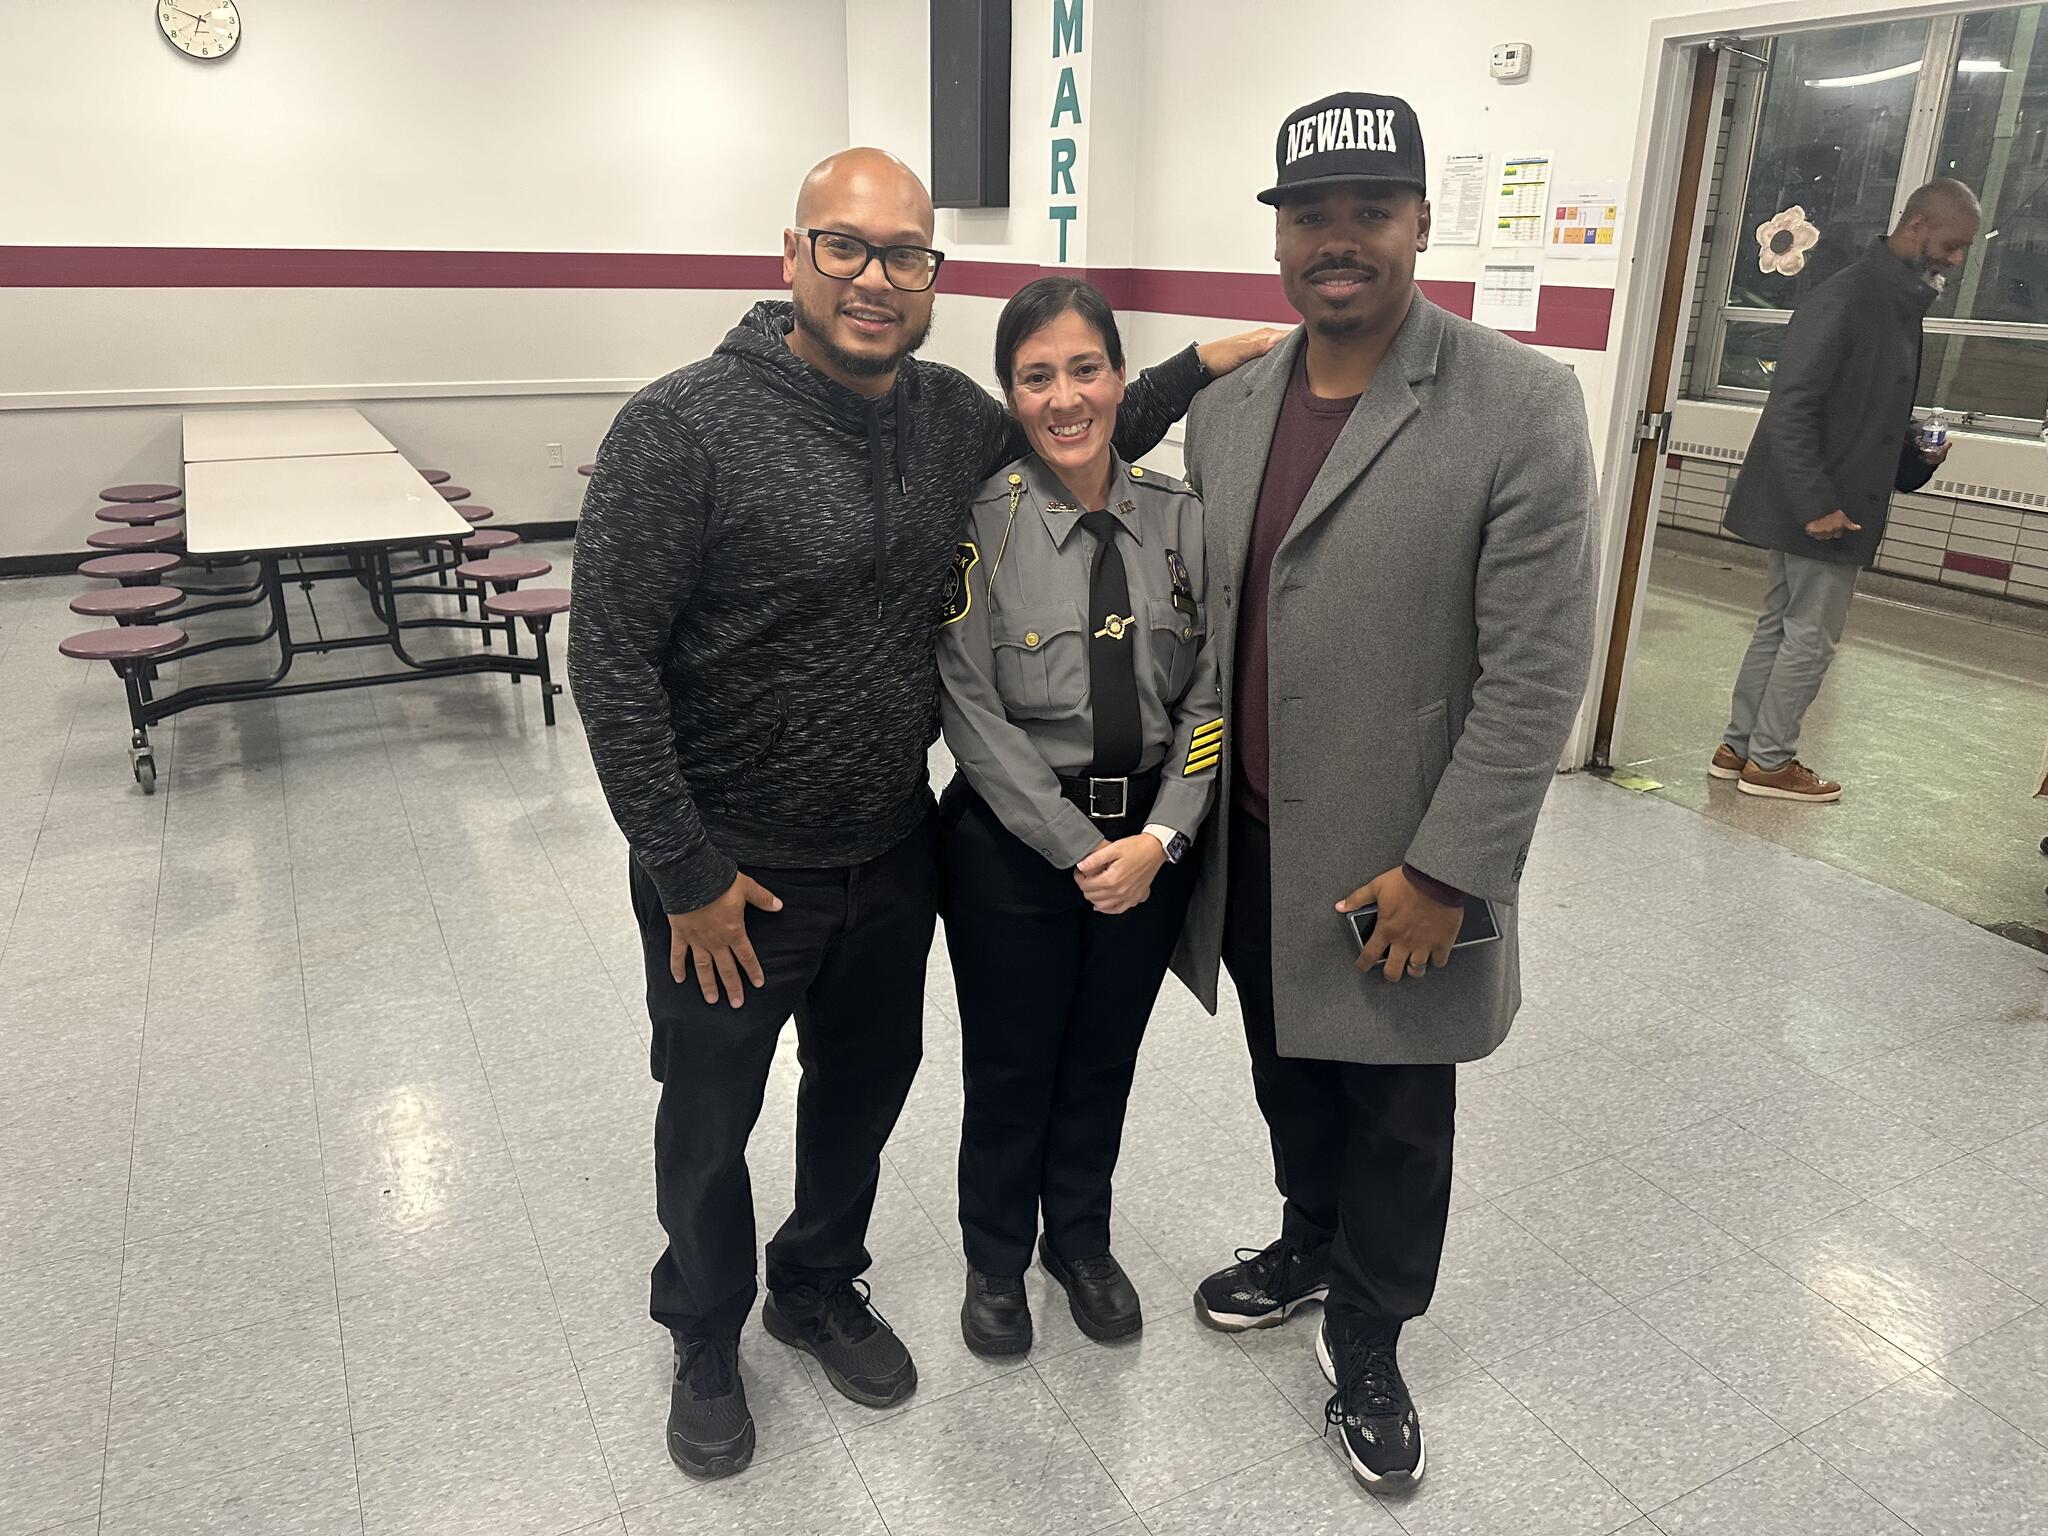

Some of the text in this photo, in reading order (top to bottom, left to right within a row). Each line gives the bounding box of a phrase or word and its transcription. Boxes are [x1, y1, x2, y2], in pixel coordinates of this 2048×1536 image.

[222, 1, 229, 9] 2
[229, 17, 235, 25] 3
[171, 30, 177, 38] 8
[227, 32, 233, 40] 4
[184, 42, 190, 50] 7
[1285, 107, 1397, 166] NEWARK
